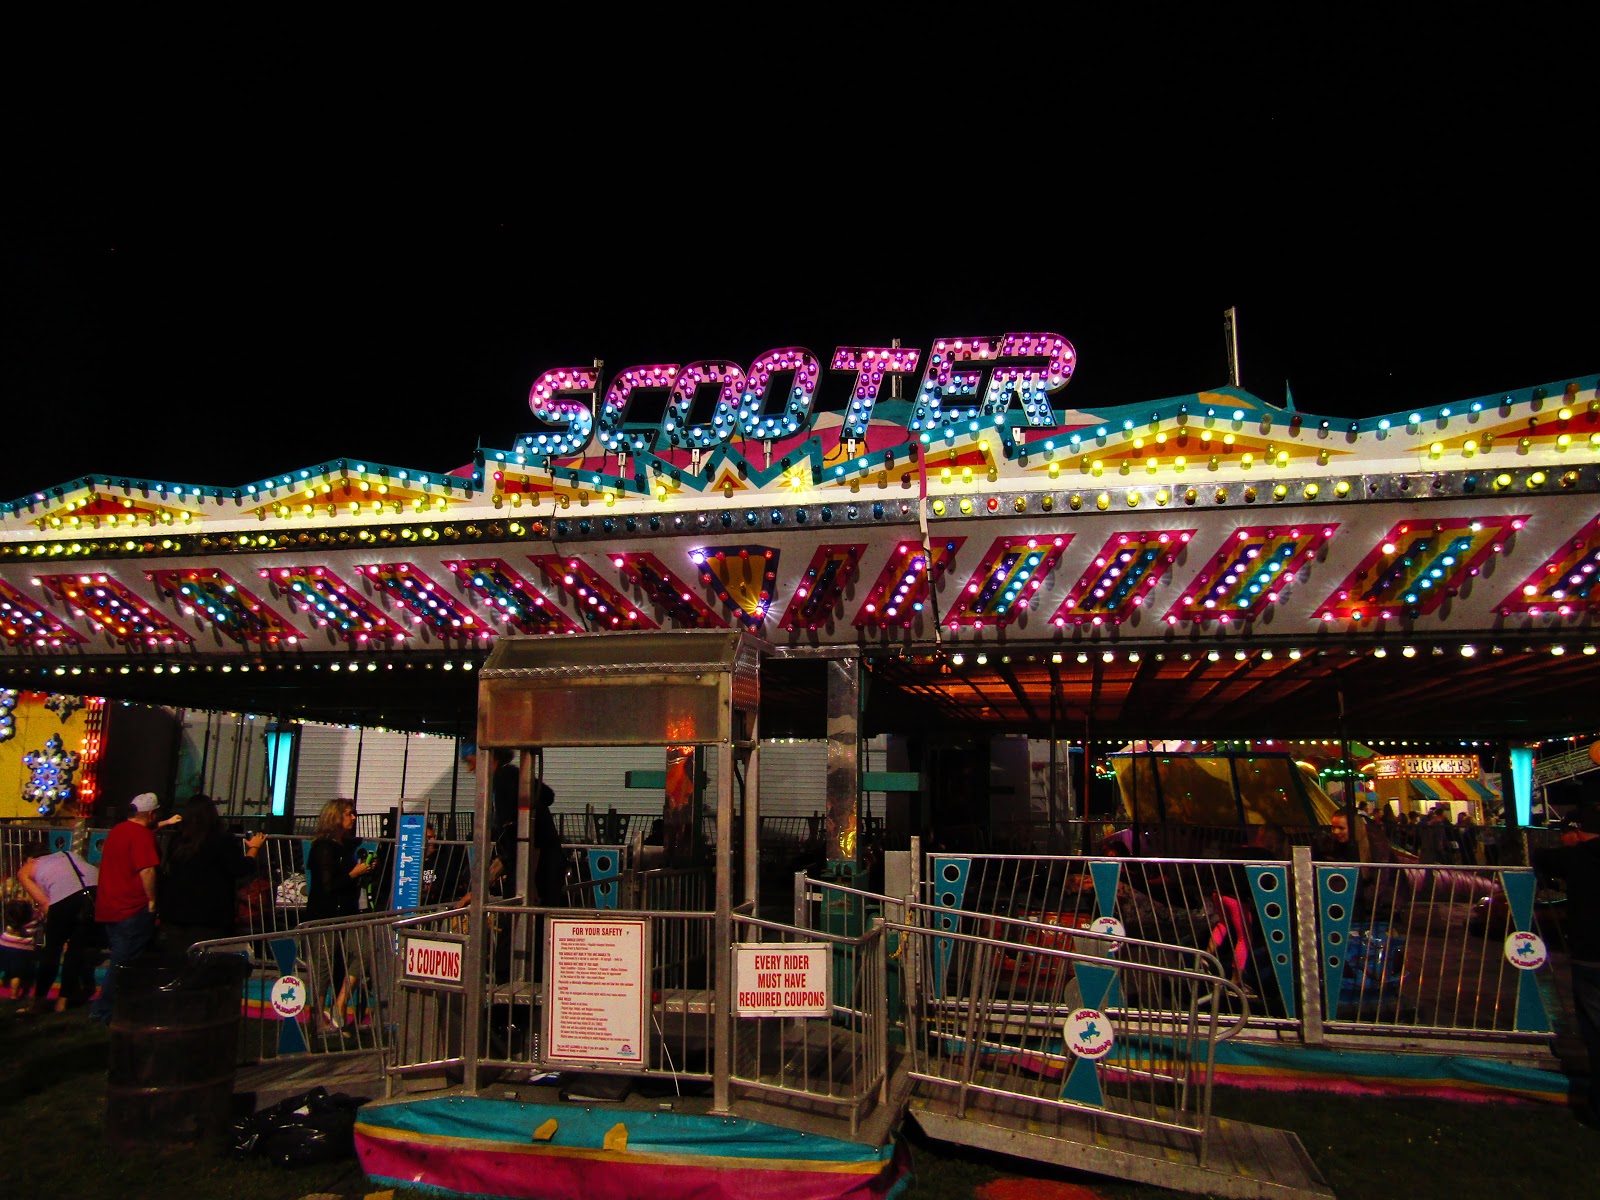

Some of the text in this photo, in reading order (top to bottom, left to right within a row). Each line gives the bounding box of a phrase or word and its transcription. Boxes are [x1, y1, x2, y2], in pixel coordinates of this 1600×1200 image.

[513, 332, 1077, 456] SCOOTER
[1408, 759, 1472, 774] TICKETS
[572, 927, 623, 937] FOR YOUR SAFETY
[408, 947, 460, 978] 3 COUPONS
[754, 955, 810, 970] EVERY RIDER
[757, 973, 806, 989] MUST HAVE
[739, 991, 825, 1008] REQUIRED COUPONS
